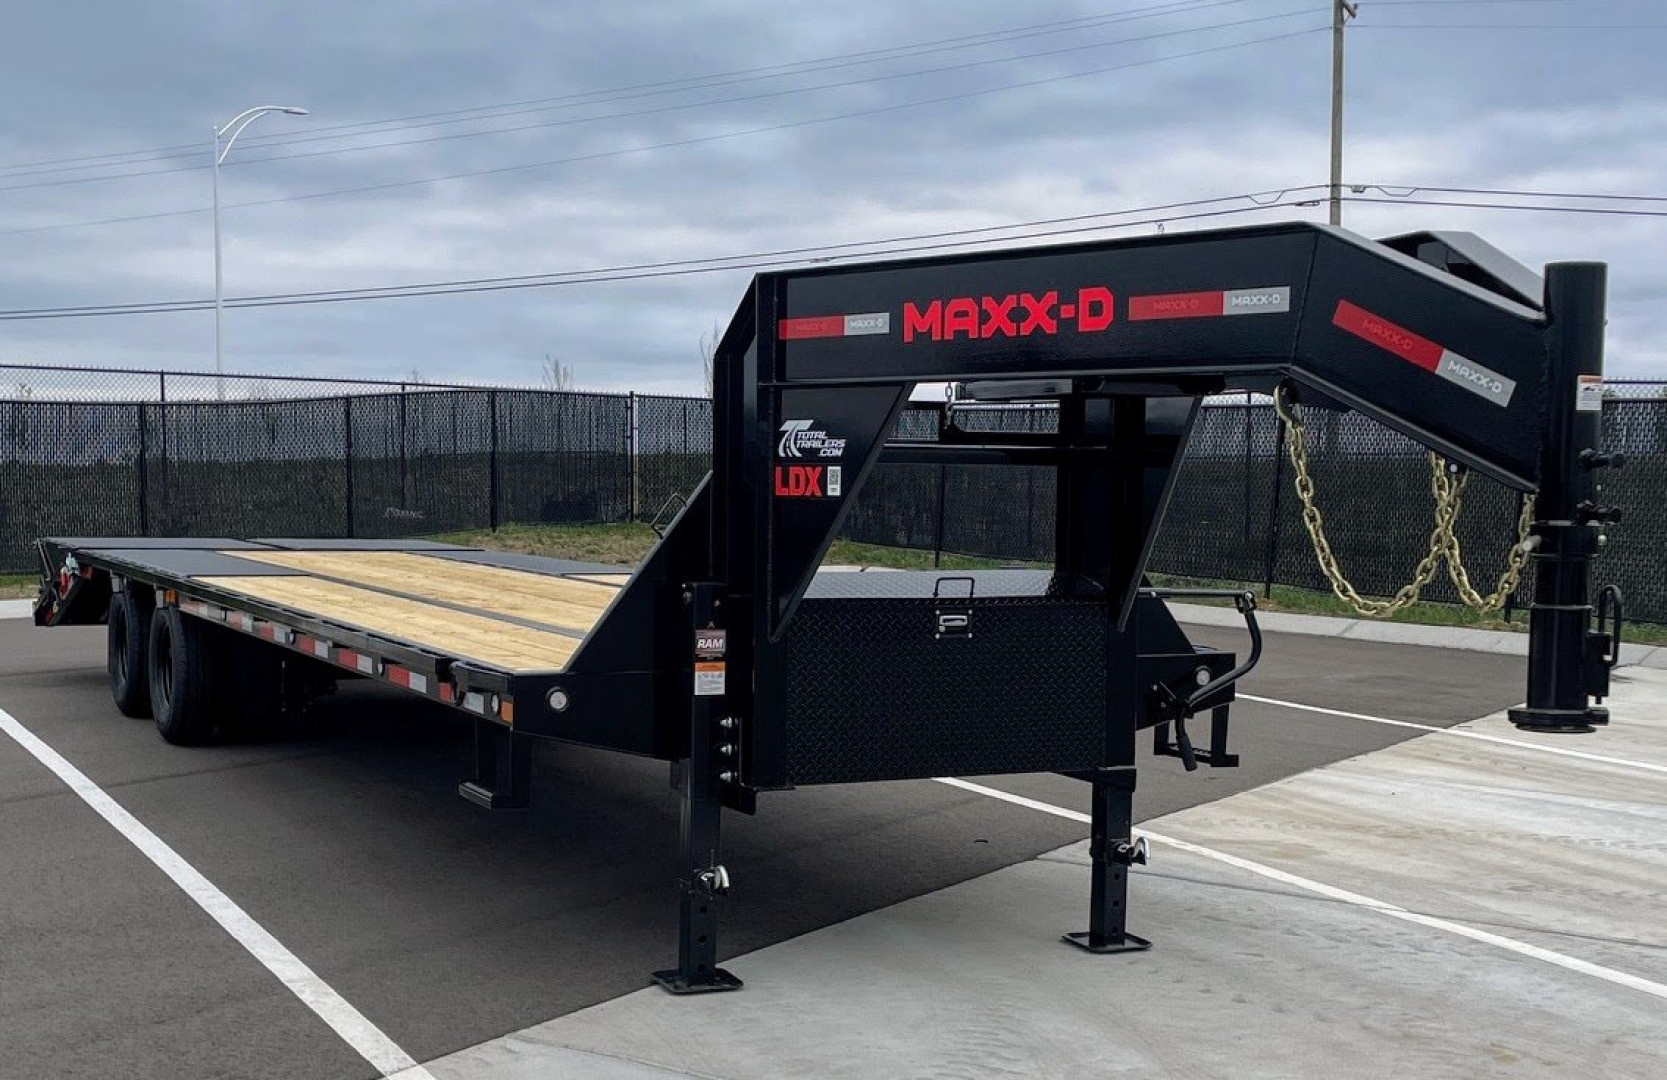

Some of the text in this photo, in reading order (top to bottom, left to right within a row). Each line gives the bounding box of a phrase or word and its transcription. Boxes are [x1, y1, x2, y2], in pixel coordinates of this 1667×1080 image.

[1231, 293, 1281, 307] MAXX-D
[903, 286, 1114, 343] MAXX-D
[1447, 360, 1502, 394] MAXX-D
[797, 431, 828, 440] TOTAL
[796, 439, 847, 449] TRAILERS
[775, 466, 823, 496] LDX
[697, 638, 724, 649] RAM
